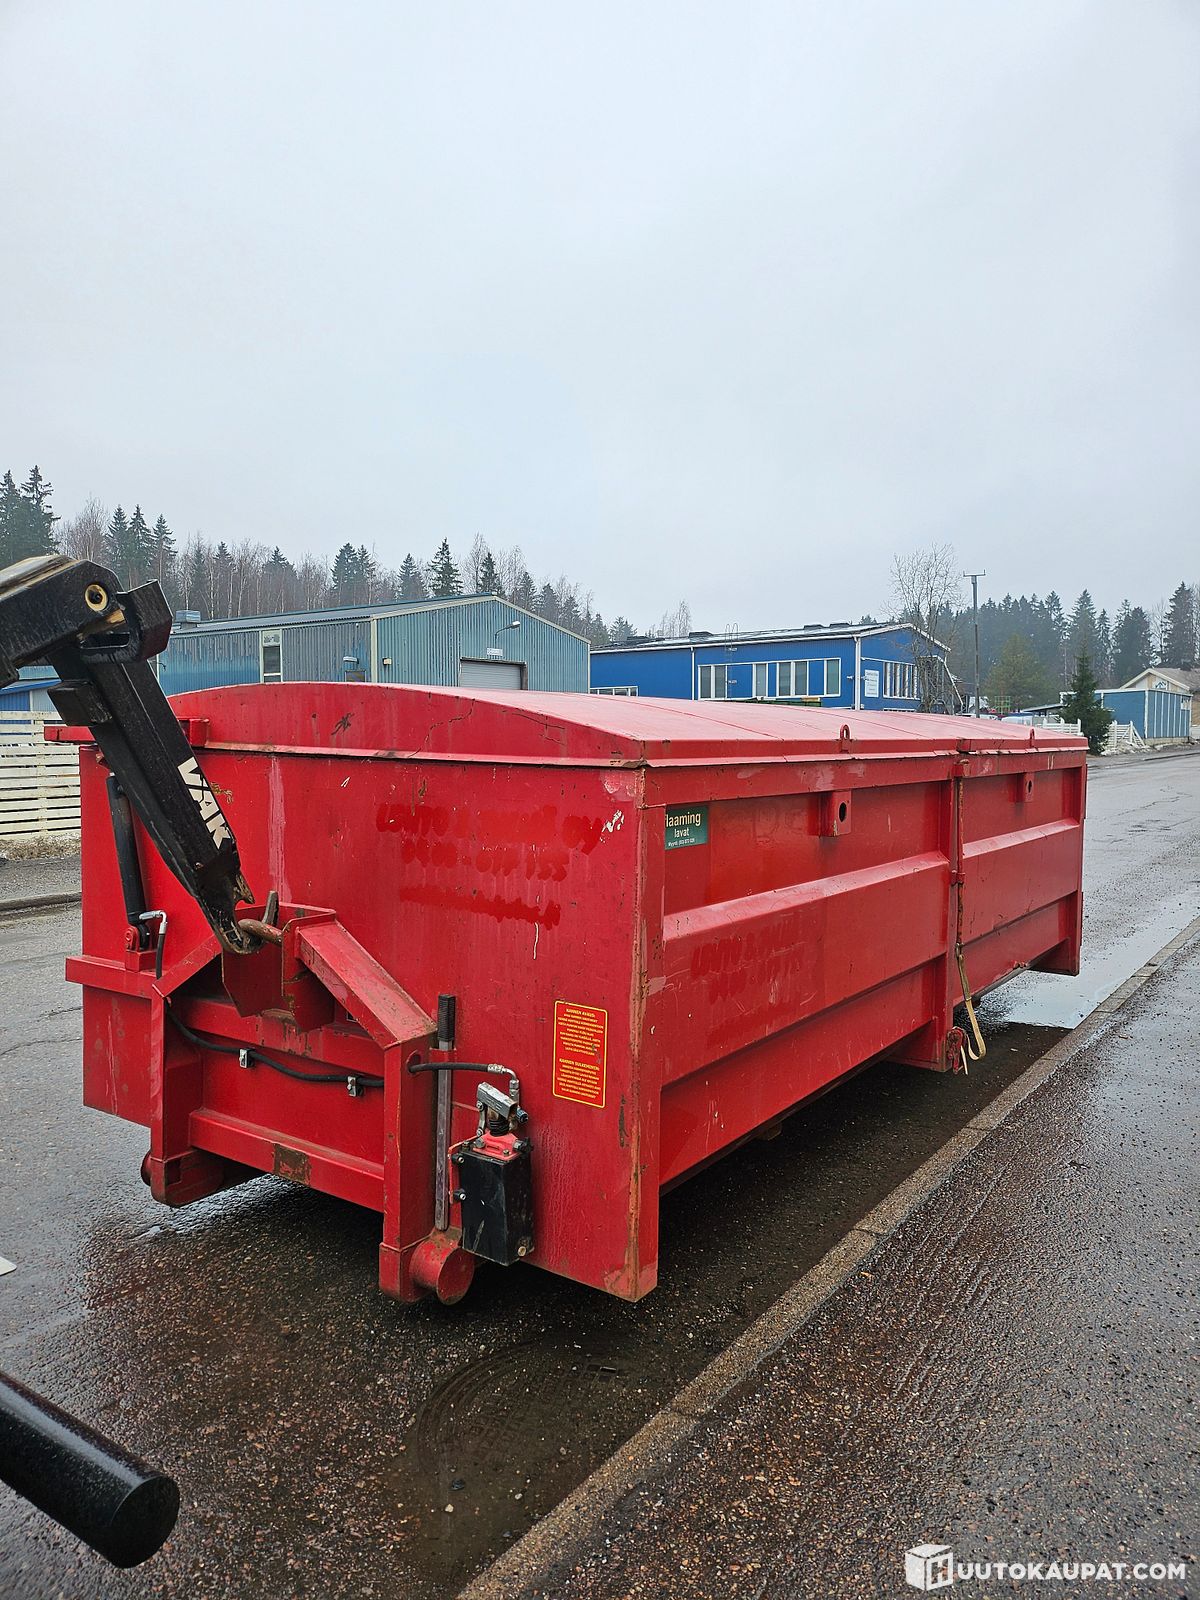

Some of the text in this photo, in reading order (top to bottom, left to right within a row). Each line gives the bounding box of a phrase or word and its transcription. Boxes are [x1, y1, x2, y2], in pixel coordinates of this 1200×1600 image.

[177, 757, 231, 850] VAK
[666, 811, 701, 827] laaming
[674, 827, 689, 838] lavat
